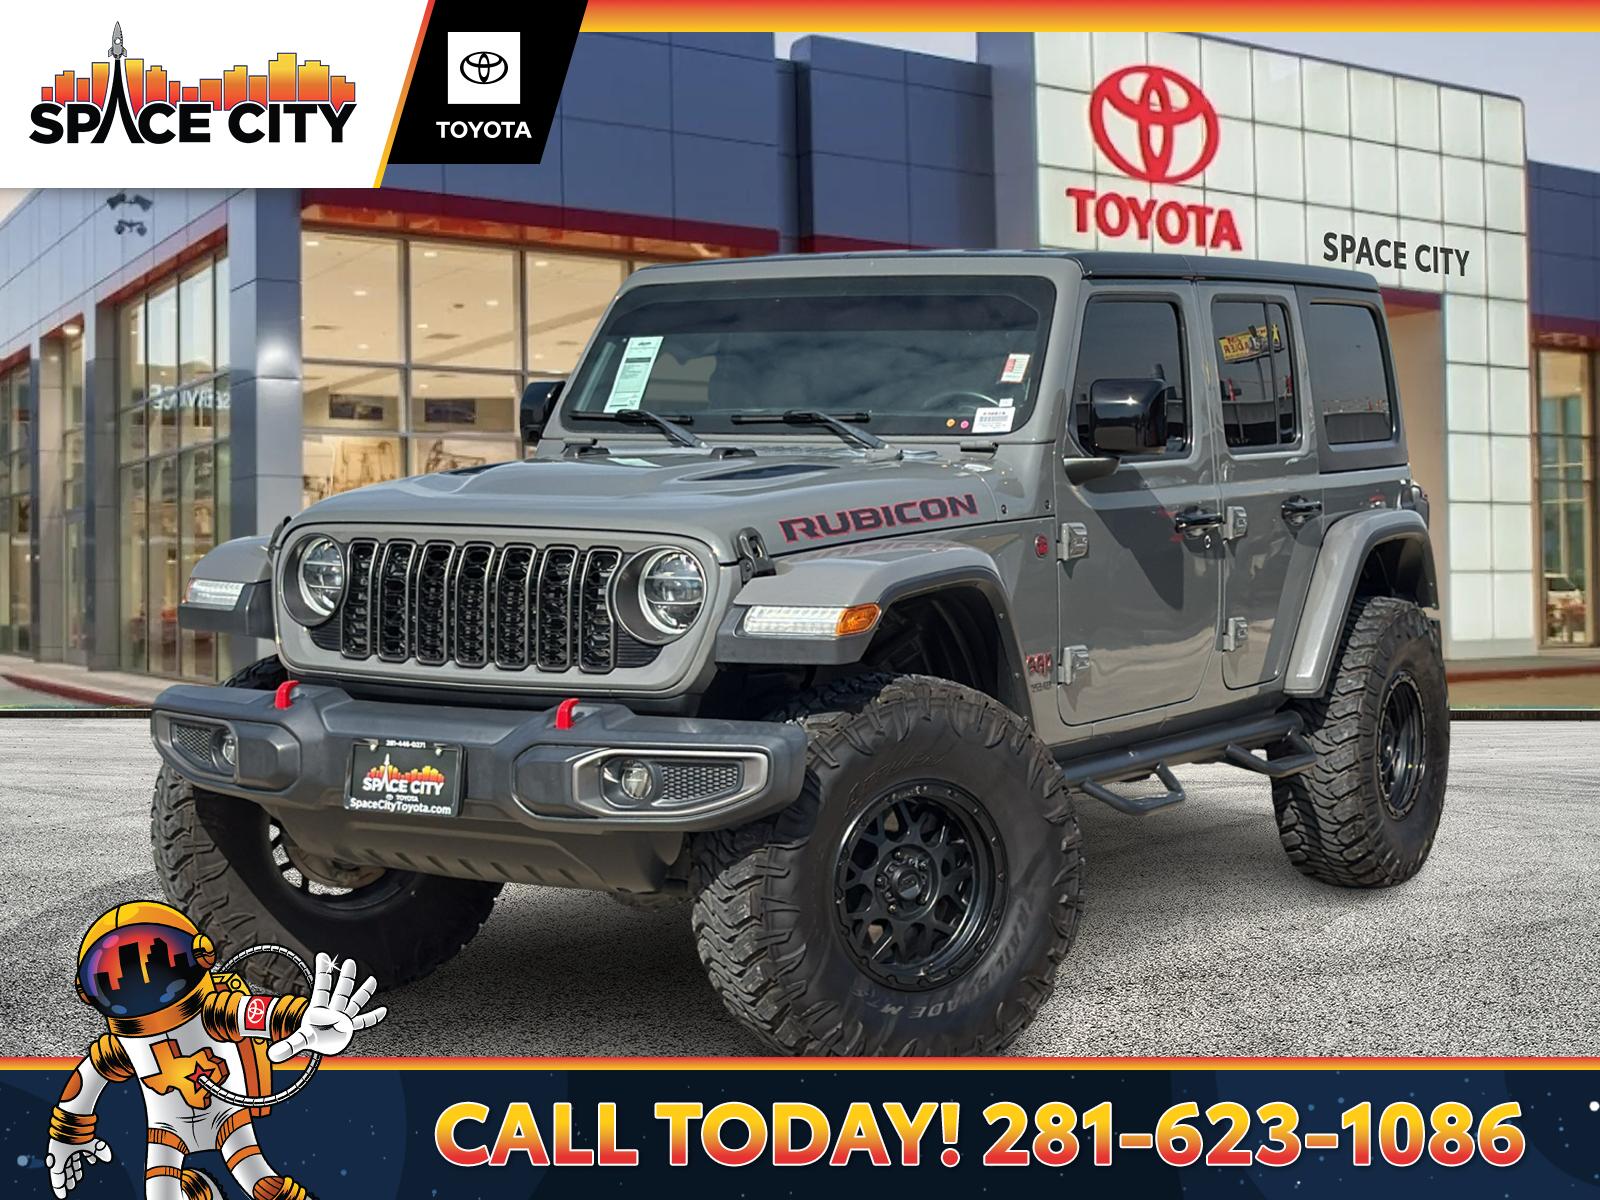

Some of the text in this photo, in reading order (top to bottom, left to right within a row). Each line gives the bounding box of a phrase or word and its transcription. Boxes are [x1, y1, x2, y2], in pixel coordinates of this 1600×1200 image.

[1066, 188, 1242, 251] TOYOTA
[1323, 232, 1470, 277] SPACE CITY
[778, 494, 979, 544] RUBICON
[362, 772, 445, 795] SPACE CITY
[350, 798, 452, 815] SpaceCityToyota.com
